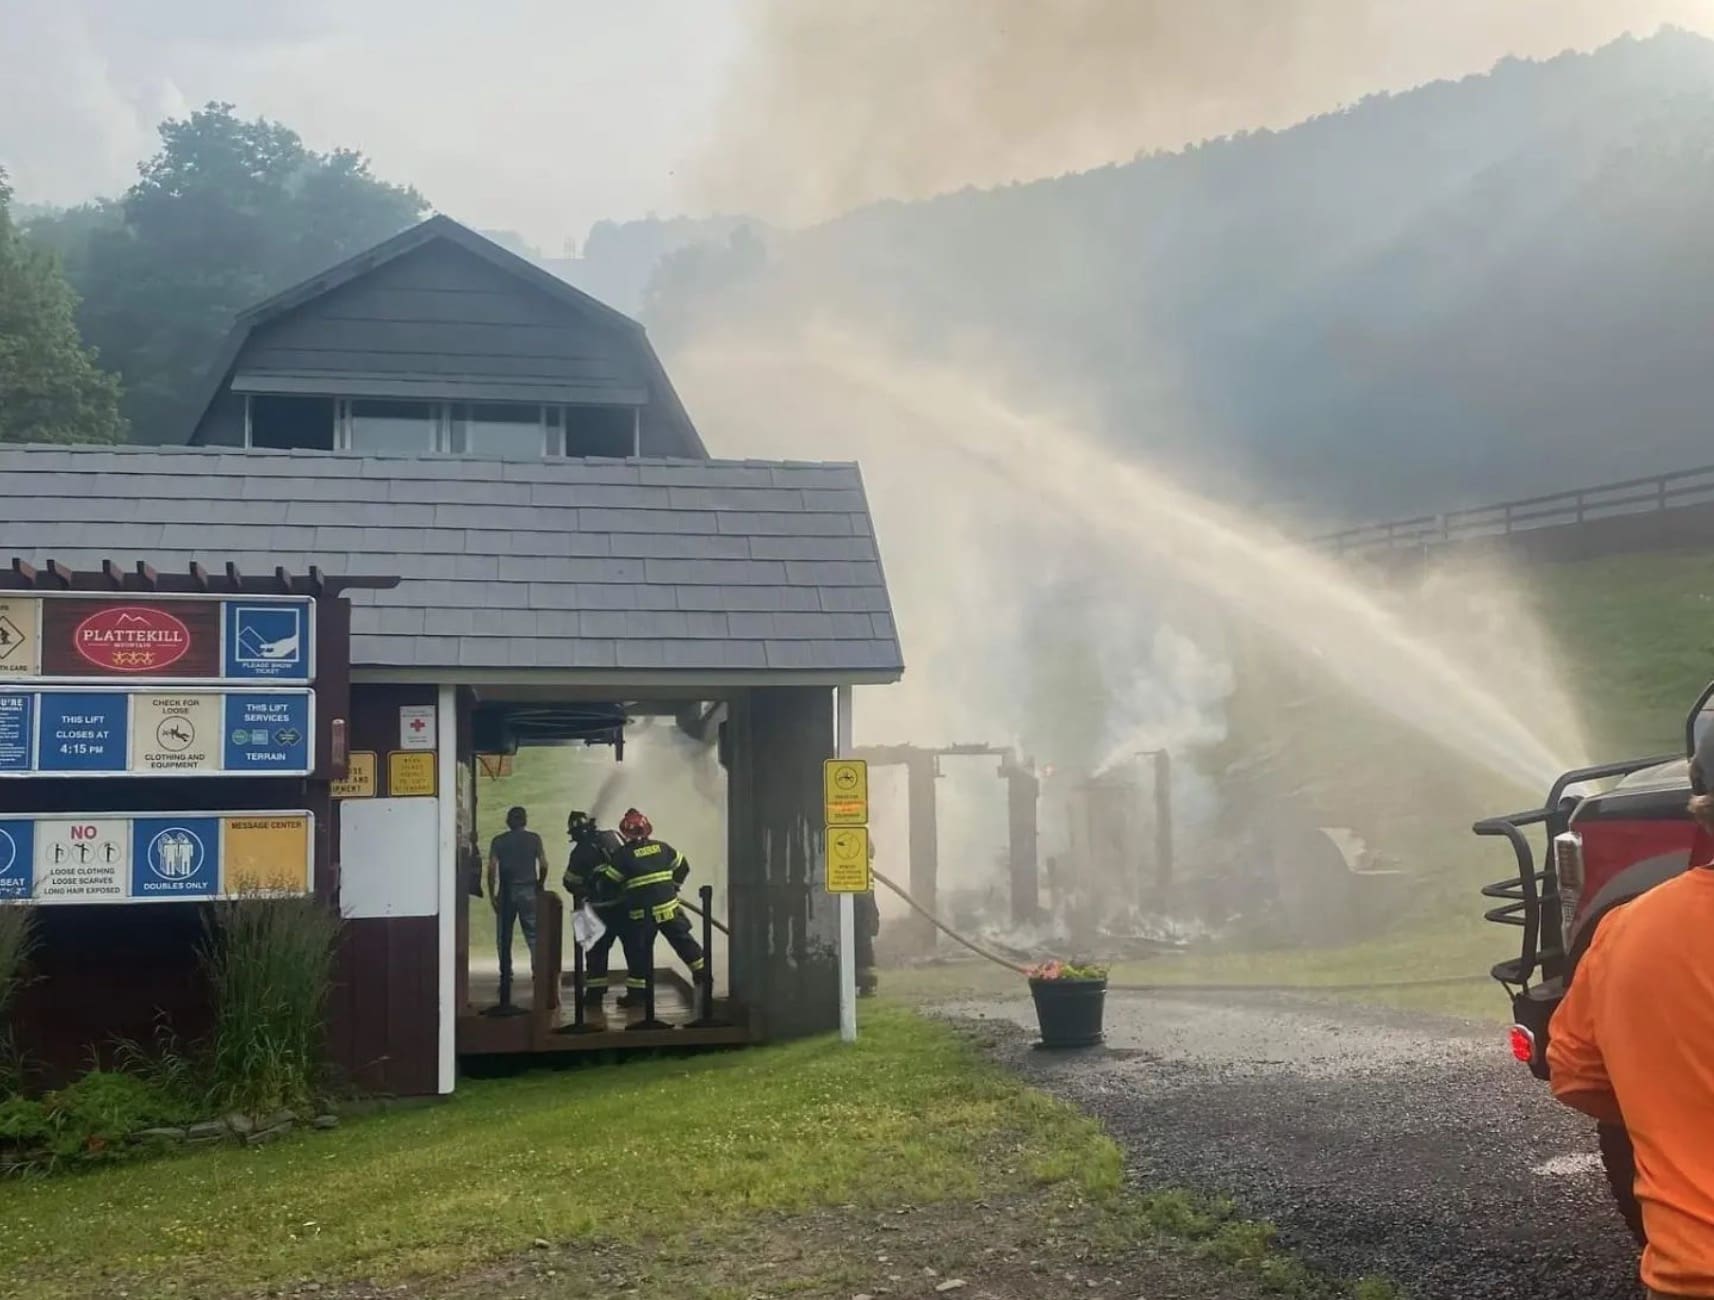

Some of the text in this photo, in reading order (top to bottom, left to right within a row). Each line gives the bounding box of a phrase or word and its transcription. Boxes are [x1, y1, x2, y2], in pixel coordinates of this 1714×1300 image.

[83, 629, 183, 642] PLATTEKILL
[245, 703, 288, 712] THIS LIFT
[61, 715, 104, 724] THIS LIFT
[244, 713, 290, 722] SERVICES
[55, 730, 110, 739] CLOSES AT
[59, 743, 104, 754] 4:15 PM
[144, 753, 186, 761] CLOTHING
[245, 752, 286, 761] TERRAIN
[231, 820, 302, 829] MESSAGE CENTER
[71, 825, 97, 840] NO
[50, 867, 115, 876] LOOSE CLOTHING
[52, 877, 78, 885] LOOSE
[143, 881, 208, 890] DOUBLES ONLY
